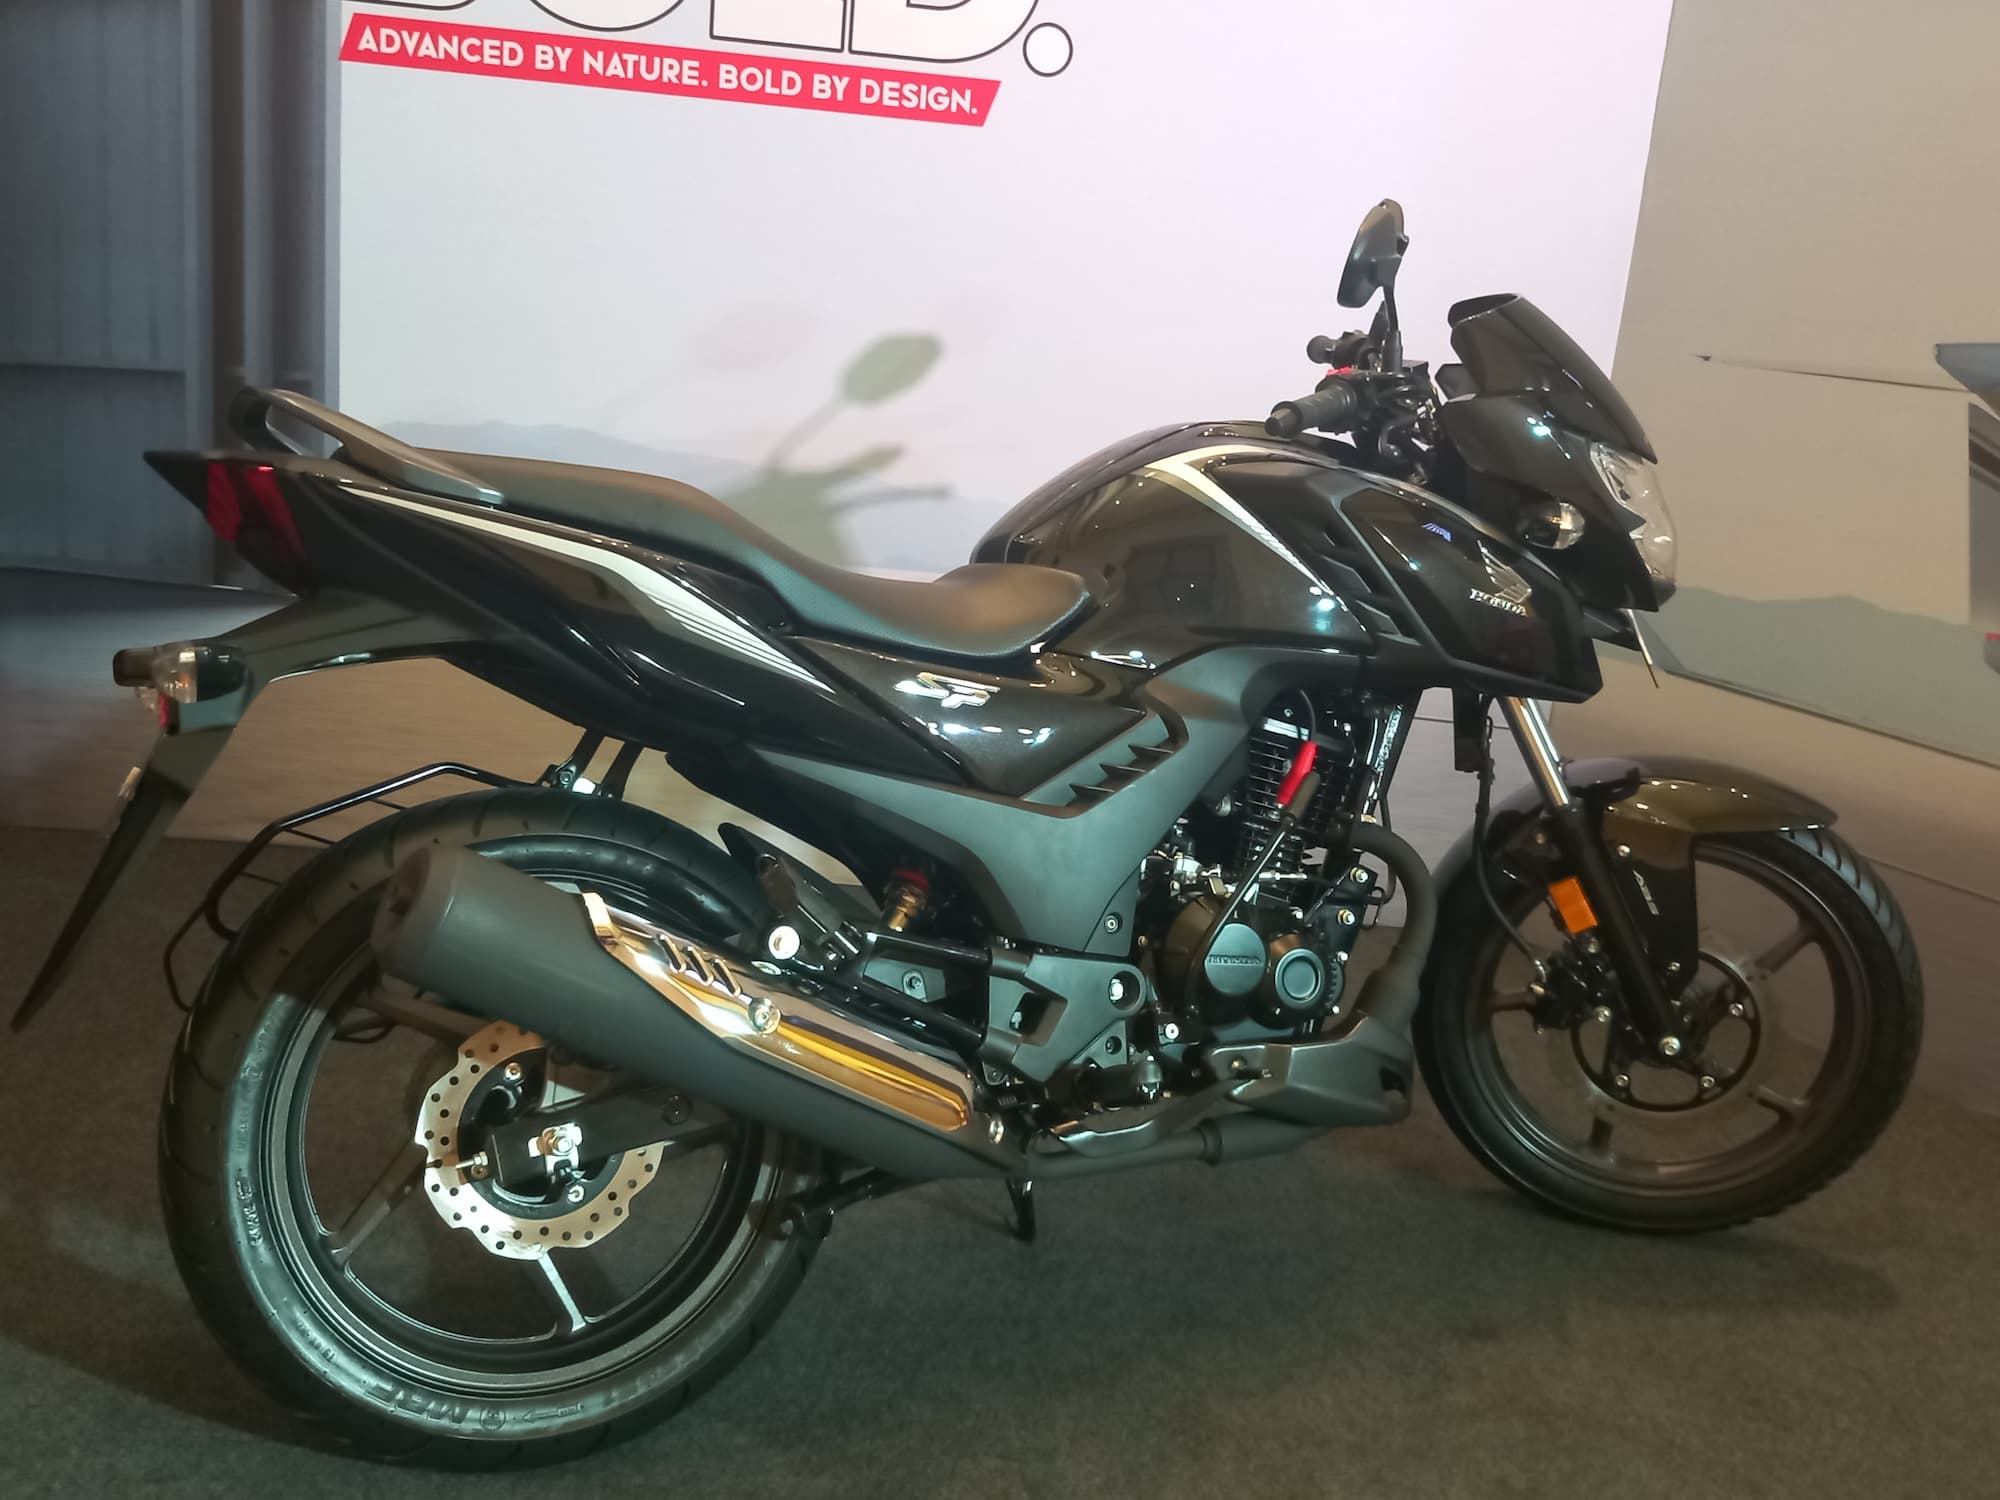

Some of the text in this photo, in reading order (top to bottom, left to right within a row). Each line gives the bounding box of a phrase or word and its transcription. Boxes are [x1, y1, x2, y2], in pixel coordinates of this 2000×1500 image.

[359, 27, 977, 114] ADVANCED BY NATURE. BOLD BY DESIGN.
